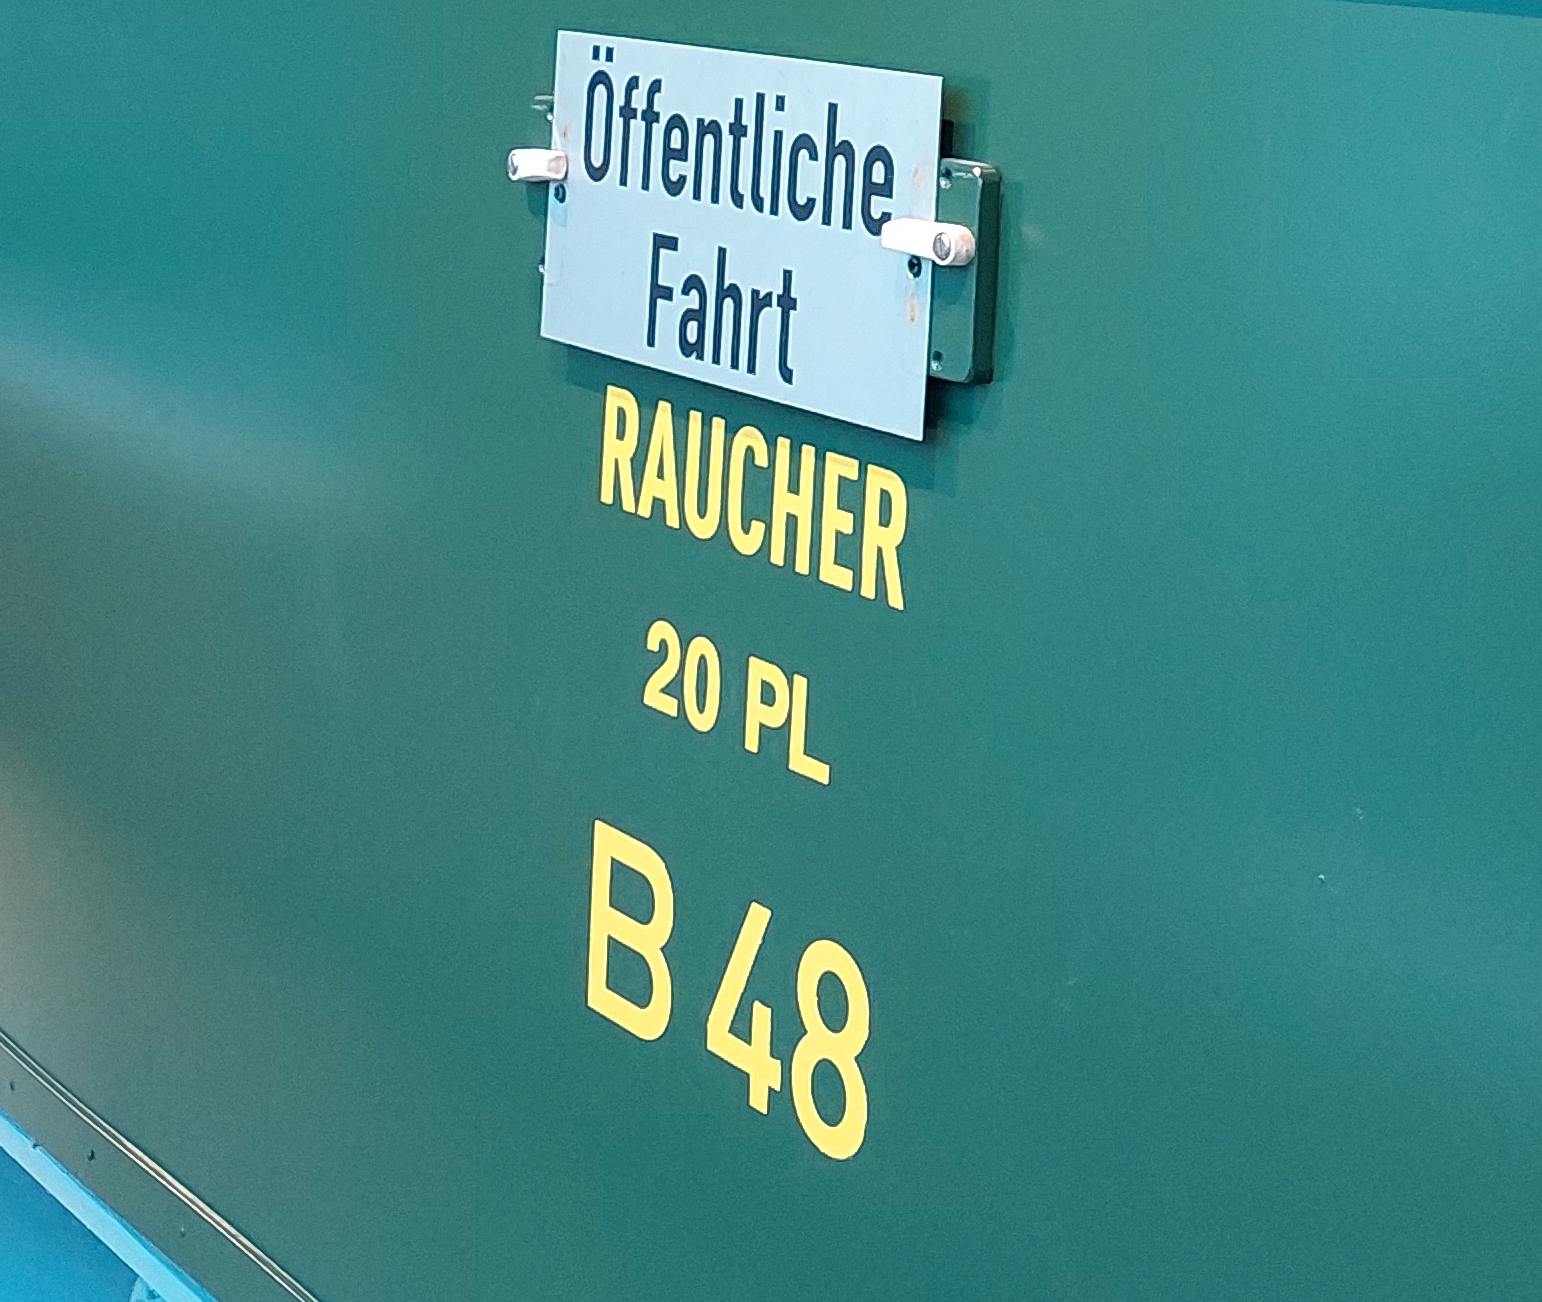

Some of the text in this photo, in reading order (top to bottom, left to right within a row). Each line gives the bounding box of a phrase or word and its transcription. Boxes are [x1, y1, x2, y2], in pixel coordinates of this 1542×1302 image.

[582, 44, 896, 238] Öffentliche
[645, 231, 799, 386] Fahrt
[599, 384, 908, 611] RAUCHER
[642, 619, 831, 786] 20 PL
[586, 818, 871, 1161] B 48
